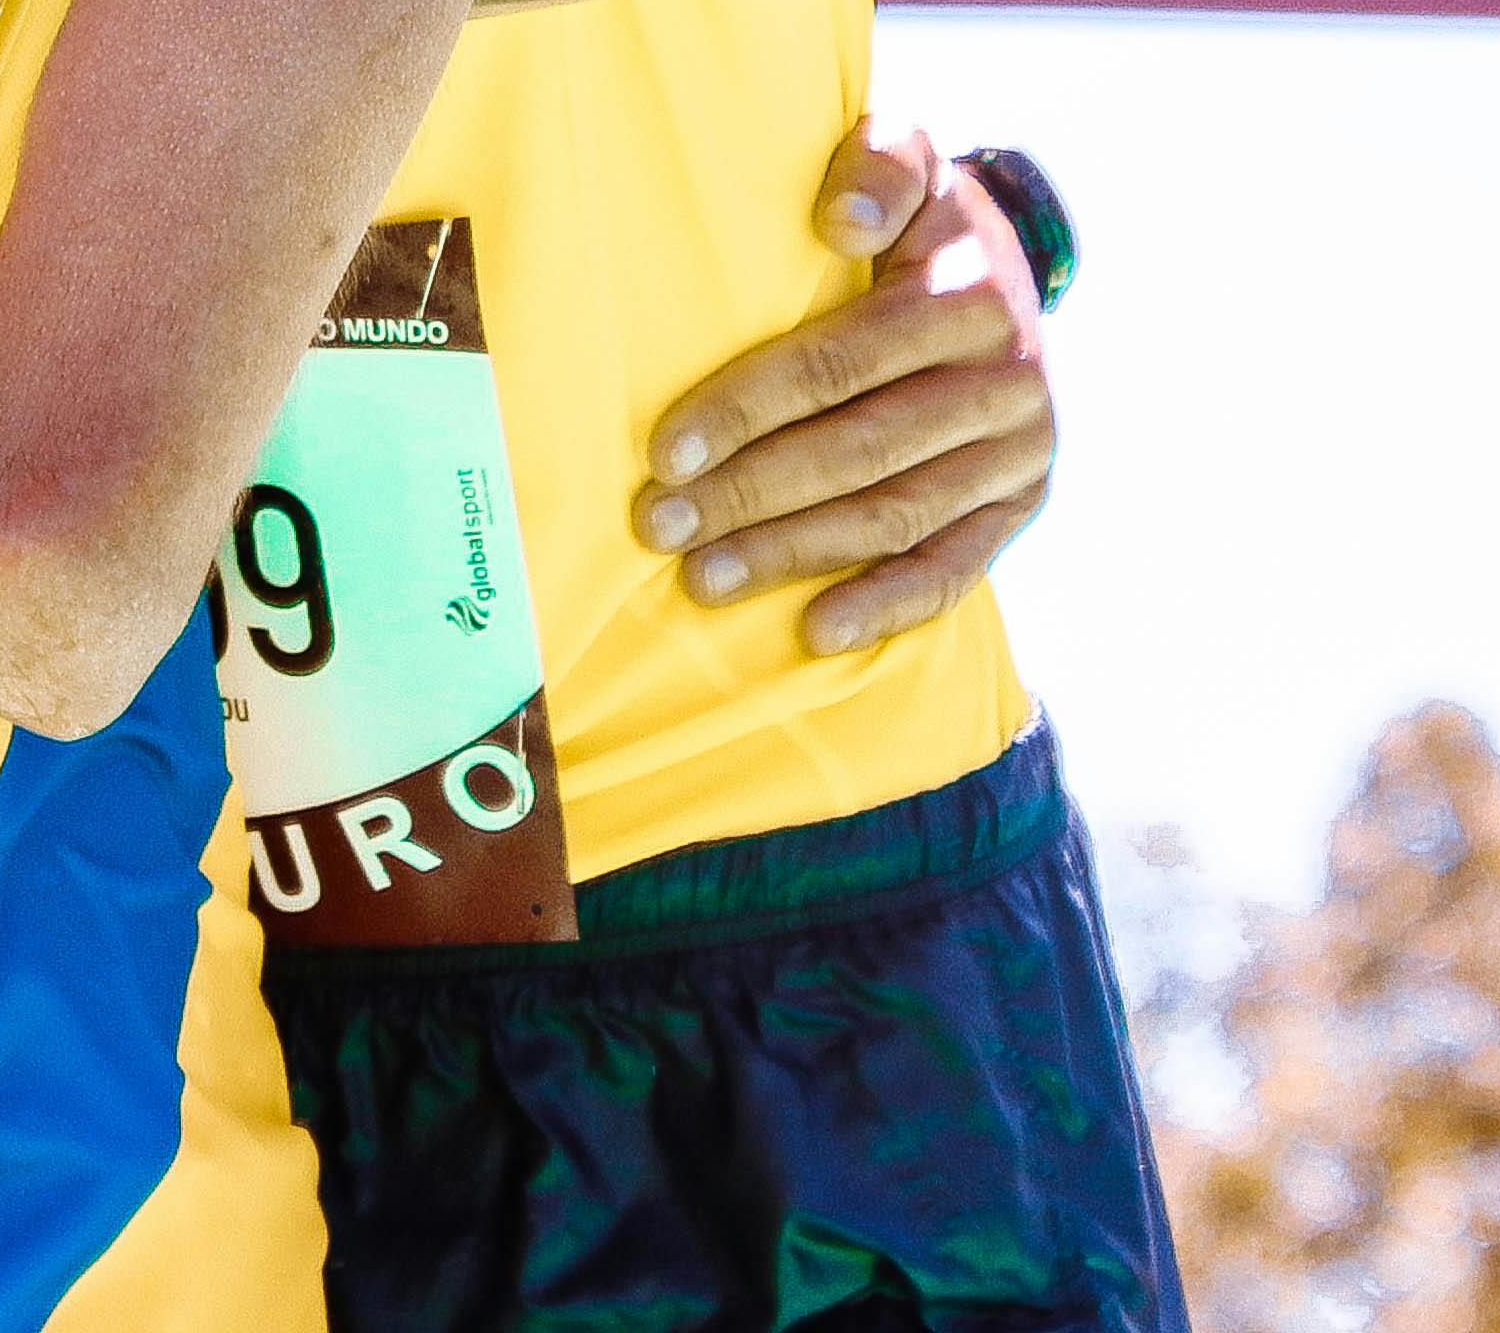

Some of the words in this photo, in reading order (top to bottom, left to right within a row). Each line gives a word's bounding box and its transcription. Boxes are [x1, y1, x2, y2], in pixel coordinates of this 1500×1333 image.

[342, 317, 449, 345] MUNDO
[208, 483, 336, 676] 9
[457, 468, 497, 602] globalsport
